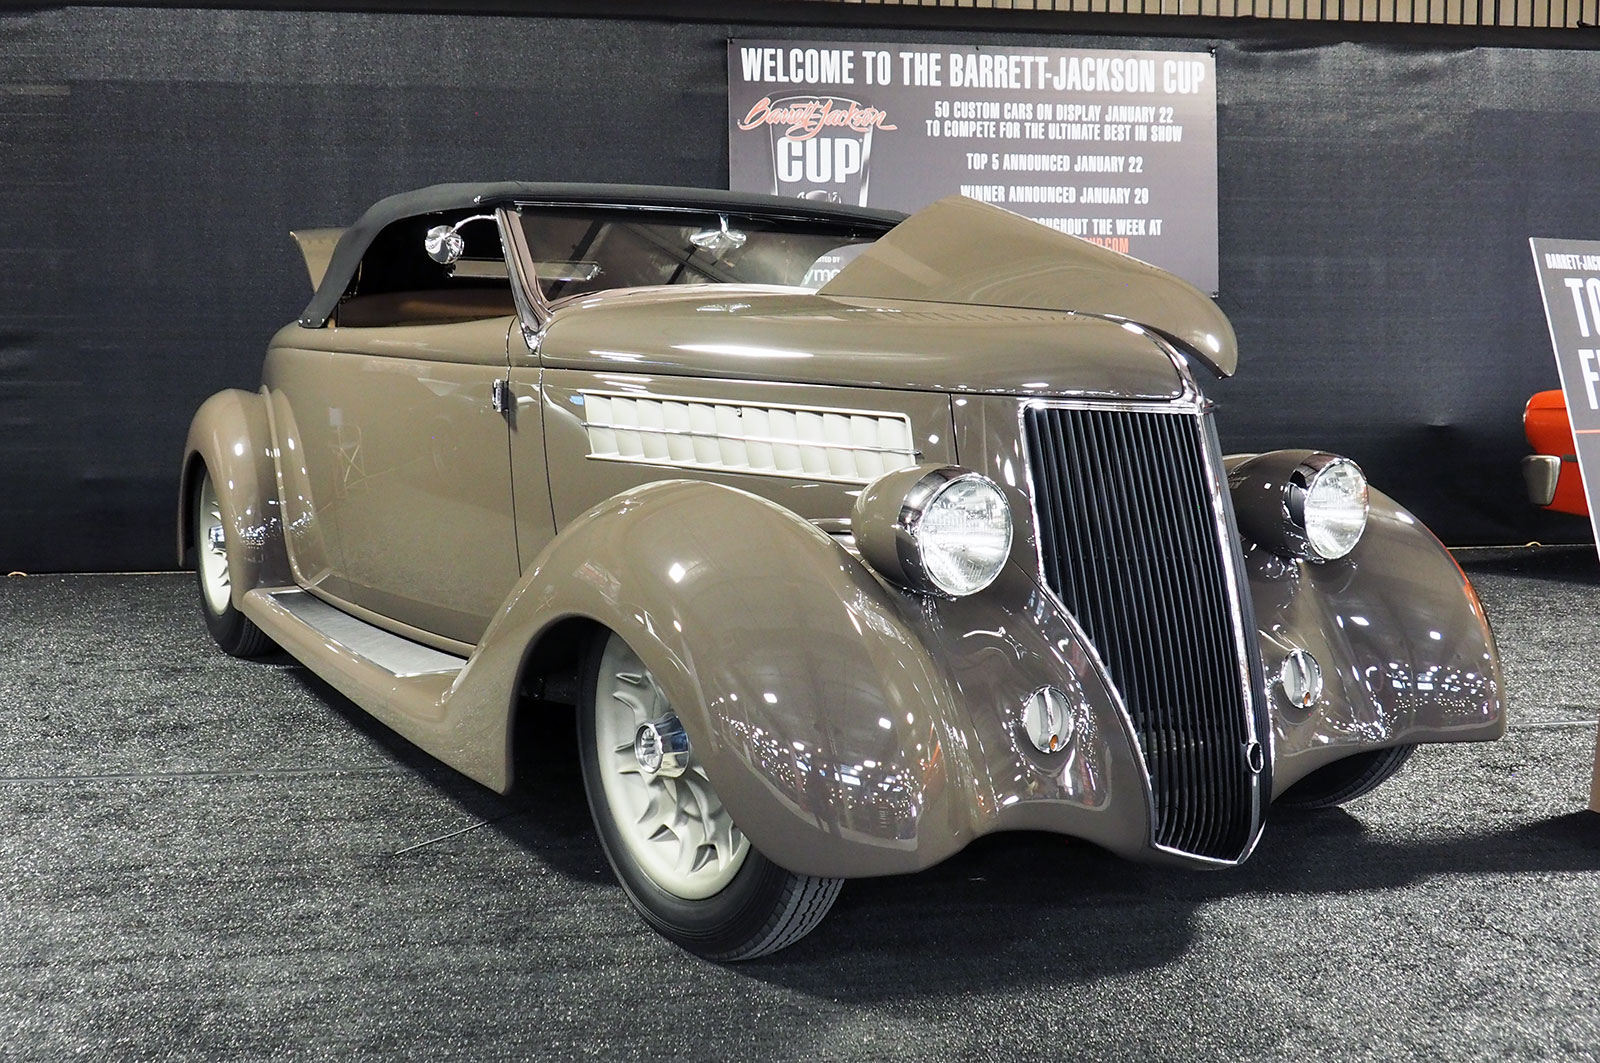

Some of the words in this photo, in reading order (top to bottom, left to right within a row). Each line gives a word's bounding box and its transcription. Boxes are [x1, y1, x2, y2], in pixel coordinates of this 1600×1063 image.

[740, 48, 855, 84] WELCOME
[862, 51, 892, 85] TO
[900, 52, 942, 86] THE
[949, 53, 1156, 93] BARRETT-JACKSON
[1163, 60, 1205, 94] CUP
[737, 97, 898, 141] Barrett-Jackson
[934, 101, 950, 118] 50
[953, 101, 1000, 119] CUSTOM
[1004, 103, 1033, 120] CARS
[1037, 103, 1053, 121] ON
[1056, 104, 1101, 122] DISPLAY
[1105, 105, 1155, 123] JANUARY
[1159, 107, 1174, 123] 22
[926, 120, 941, 137] TO
[944, 121, 996, 138] COMPETE
[1000, 122, 1021, 139] FOR
[1024, 122, 1045, 139] THE
[1048, 123, 1100, 140] ULTIMATE
[1104, 124, 1131, 141] BEST
[1135, 125, 1148, 141] IN
[1151, 125, 1182, 142] SHOW
[777, 137, 861, 183] CUP
[966, 153, 988, 170] TOP
[991, 154, 999, 170] 5
[1003, 154, 1070, 171] ANNOUNCED
[1074, 155, 1124, 173] JANUARY
[1128, 156, 1143, 173] 22
[960, 184, 1005, 202] WINNER
[1008, 186, 1076, 203] ANNOUNCED
[1080, 187, 1130, 204] JANUARY
[1031, 217, 1088, 235] UGHOUT
[1092, 219, 1113, 235] THE
[1115, 219, 1146, 235] WEEK
[1148, 219, 1163, 236] AT
[1545, 253, 1600, 271] BARRETT-JAC
